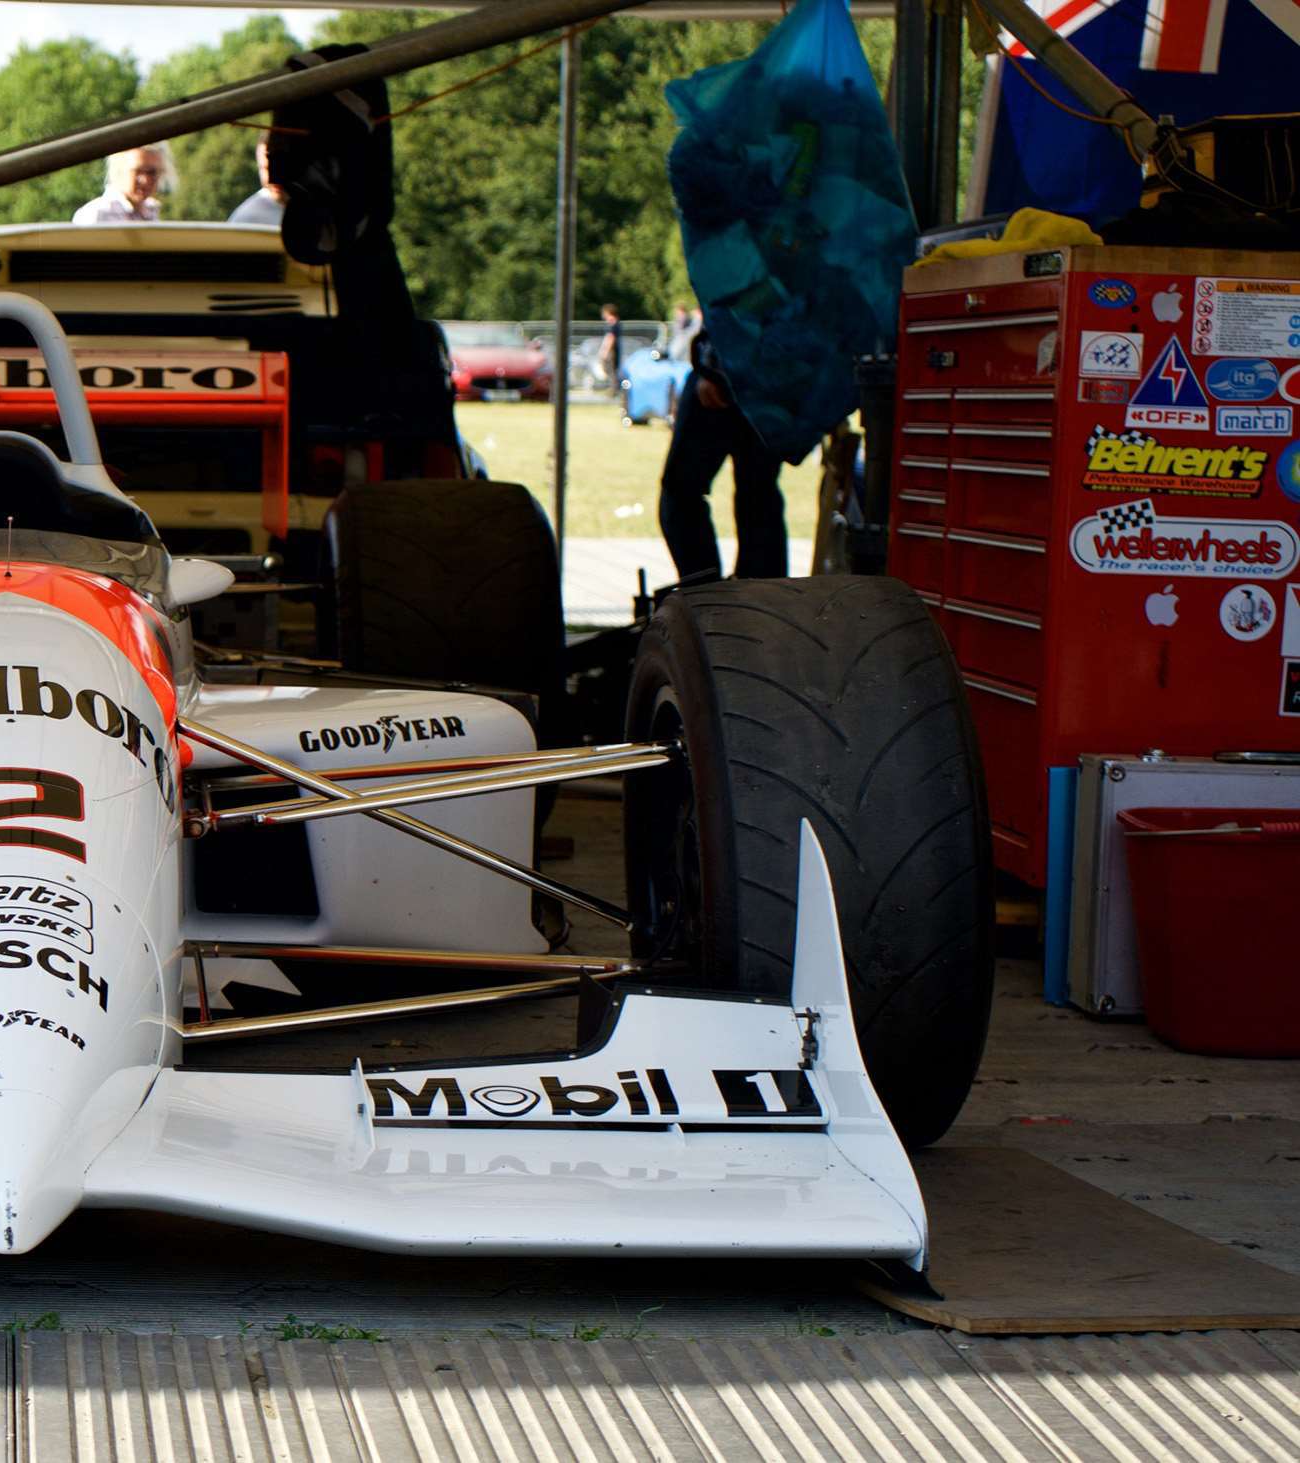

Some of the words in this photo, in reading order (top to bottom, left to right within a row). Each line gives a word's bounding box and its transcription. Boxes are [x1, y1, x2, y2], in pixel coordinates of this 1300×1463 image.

[1246, 282, 1291, 294] WARNING
[1145, 409, 1194, 425] OFF
[1225, 411, 1284, 430] march
[1088, 438, 1268, 480] Behrent's
[1088, 474, 1175, 487] Performance
[1180, 479, 1256, 491] Warehouse
[1093, 527, 1281, 565] wellerwheels
[1098, 559, 1131, 570] The
[1138, 561, 1205, 572] racer's
[1212, 563, 1275, 575] choice
[299, 715, 466, 754] GOODYEAR
[365, 1068, 680, 1117] Mobil
[744, 1071, 788, 1112] 1
